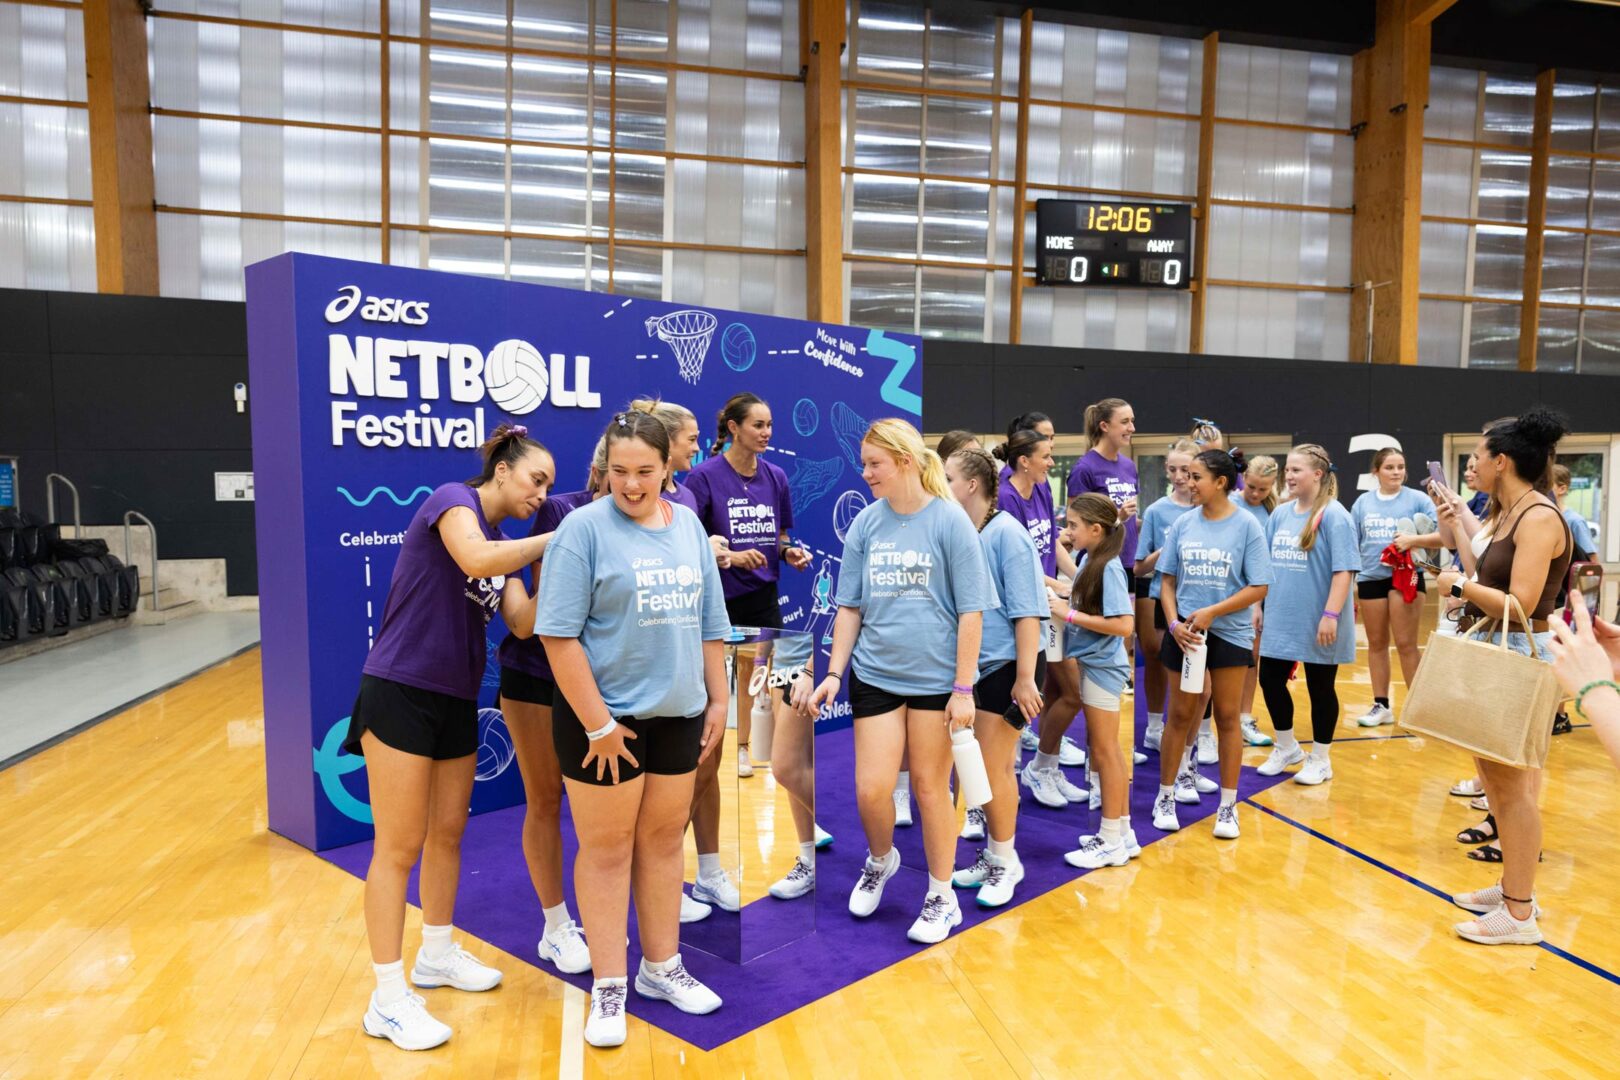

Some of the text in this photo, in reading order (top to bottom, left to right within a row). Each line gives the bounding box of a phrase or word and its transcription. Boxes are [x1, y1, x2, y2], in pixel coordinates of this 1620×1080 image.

[1087, 205, 1152, 233] 12:06
[1045, 236, 1074, 250] HOME
[1146, 239, 1175, 253] AWAY
[1069, 256, 1088, 283] 0
[1163, 259, 1182, 285] 0
[816, 327, 838, 348] Move
[804, 339, 864, 378] Confidence
[331, 401, 485, 449] Festival
[730, 518, 776, 535] Festival
[869, 566, 931, 588] Festival
[1182, 561, 1231, 578] Festival
[782, 605, 805, 624] ourt
